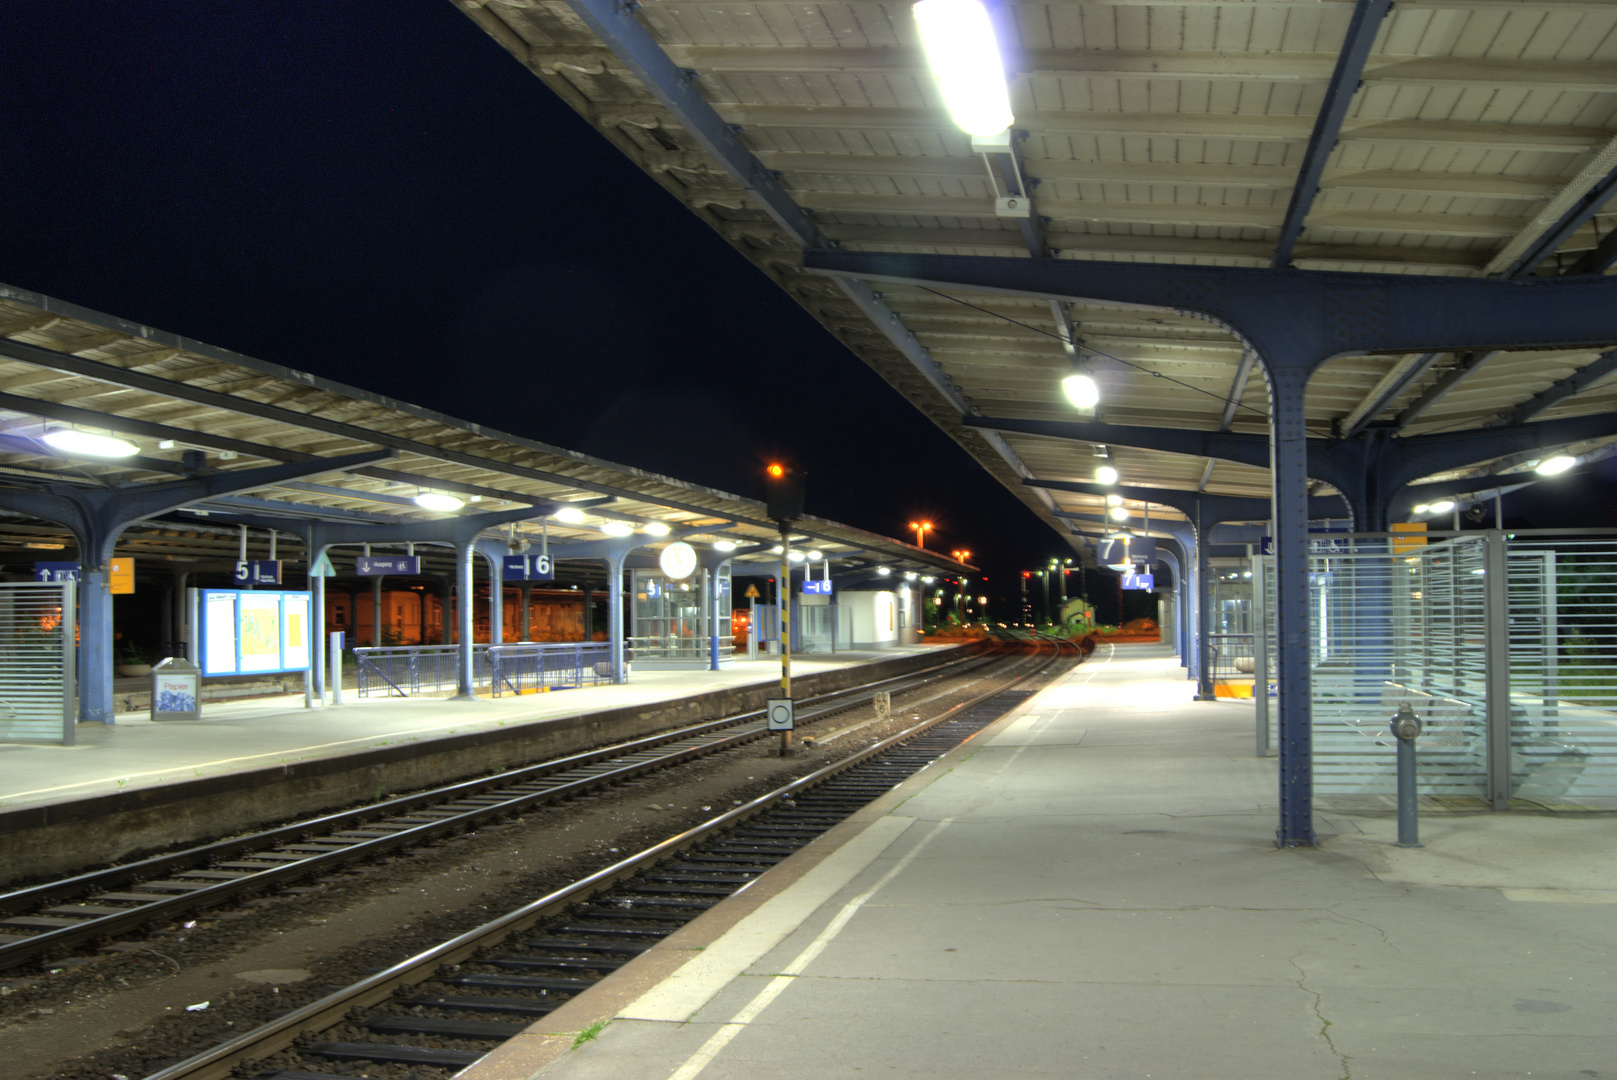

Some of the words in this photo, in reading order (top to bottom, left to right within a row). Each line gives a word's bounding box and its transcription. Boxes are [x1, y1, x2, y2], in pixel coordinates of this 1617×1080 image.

[1101, 539, 1115, 560] 7
[235, 561, 249, 580] 5
[536, 555, 550, 574] 6
[822, 580, 831, 592] 6
[1124, 573, 1134, 586] 7
[647, 584, 656, 595] 5
[164, 682, 189, 691] Papier
